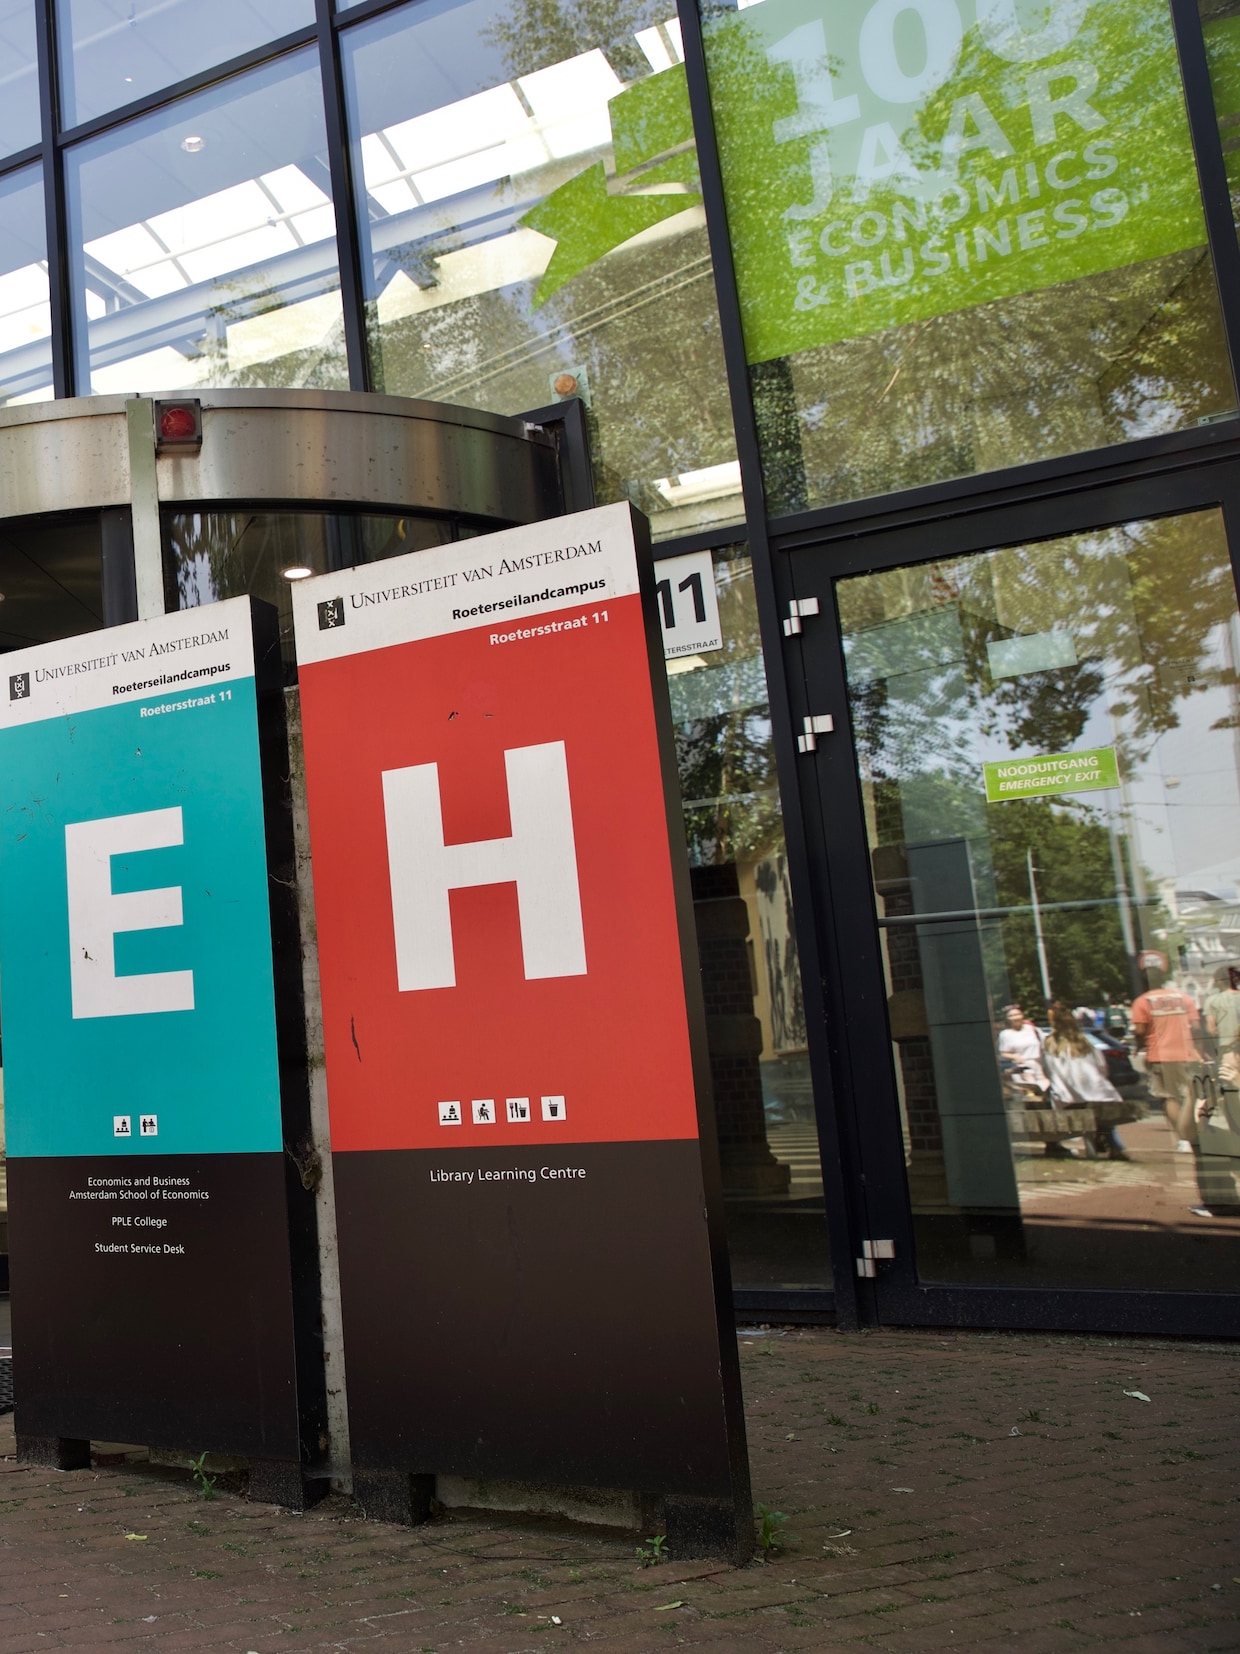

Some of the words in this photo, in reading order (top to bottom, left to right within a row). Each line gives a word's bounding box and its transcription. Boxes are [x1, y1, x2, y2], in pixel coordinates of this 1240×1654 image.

[781, 59, 1111, 220] JAAR
[788, 140, 1119, 268] ECONOMICS
[793, 274, 832, 312] &
[844, 187, 1130, 300] BUSINESS
[349, 572, 458, 610] UNIVERSITEIT
[462, 565, 494, 584] VAN
[498, 539, 603, 576] AMSTERDAM
[452, 578, 607, 620] Roeterseilandcampus
[656, 572, 707, 630] 11
[489, 614, 588, 646] Roetersstraat
[591, 610, 610, 625] 11
[34, 653, 118, 684] UNIVERSITEIT
[148, 629, 230, 657] AMSTERDAM
[664, 639, 719, 657] TERSSTRAAT
[112, 661, 232, 696] Roeterseilandcampus
[139, 692, 216, 719] Roetersstraat
[219, 690, 233, 702] 11
[997, 755, 1099, 779] NOODUITGANG
[999, 773, 1072, 792] EMERGENCY
[1075, 770, 1102, 783] EXIT
[381, 740, 588, 992] H
[65, 806, 195, 1019] E
[87, 1176, 133, 1187] Economics
[134, 1176, 151, 1187] and
[153, 1176, 190, 1187] Business
[429, 1168, 475, 1185] Library
[477, 1167, 537, 1183] Learning
[540, 1166, 587, 1181] Centre
[69, 1189, 118, 1200] Amsterdam
[119, 1189, 148, 1200] School
[150, 1189, 161, 1200] of
[162, 1189, 210, 1200] Economics
[111, 1216, 132, 1227] PPLE
[134, 1216, 168, 1229] College
[94, 1242, 129, 1253] Student
[130, 1243, 161, 1254] Service
[163, 1243, 186, 1255] Desk
